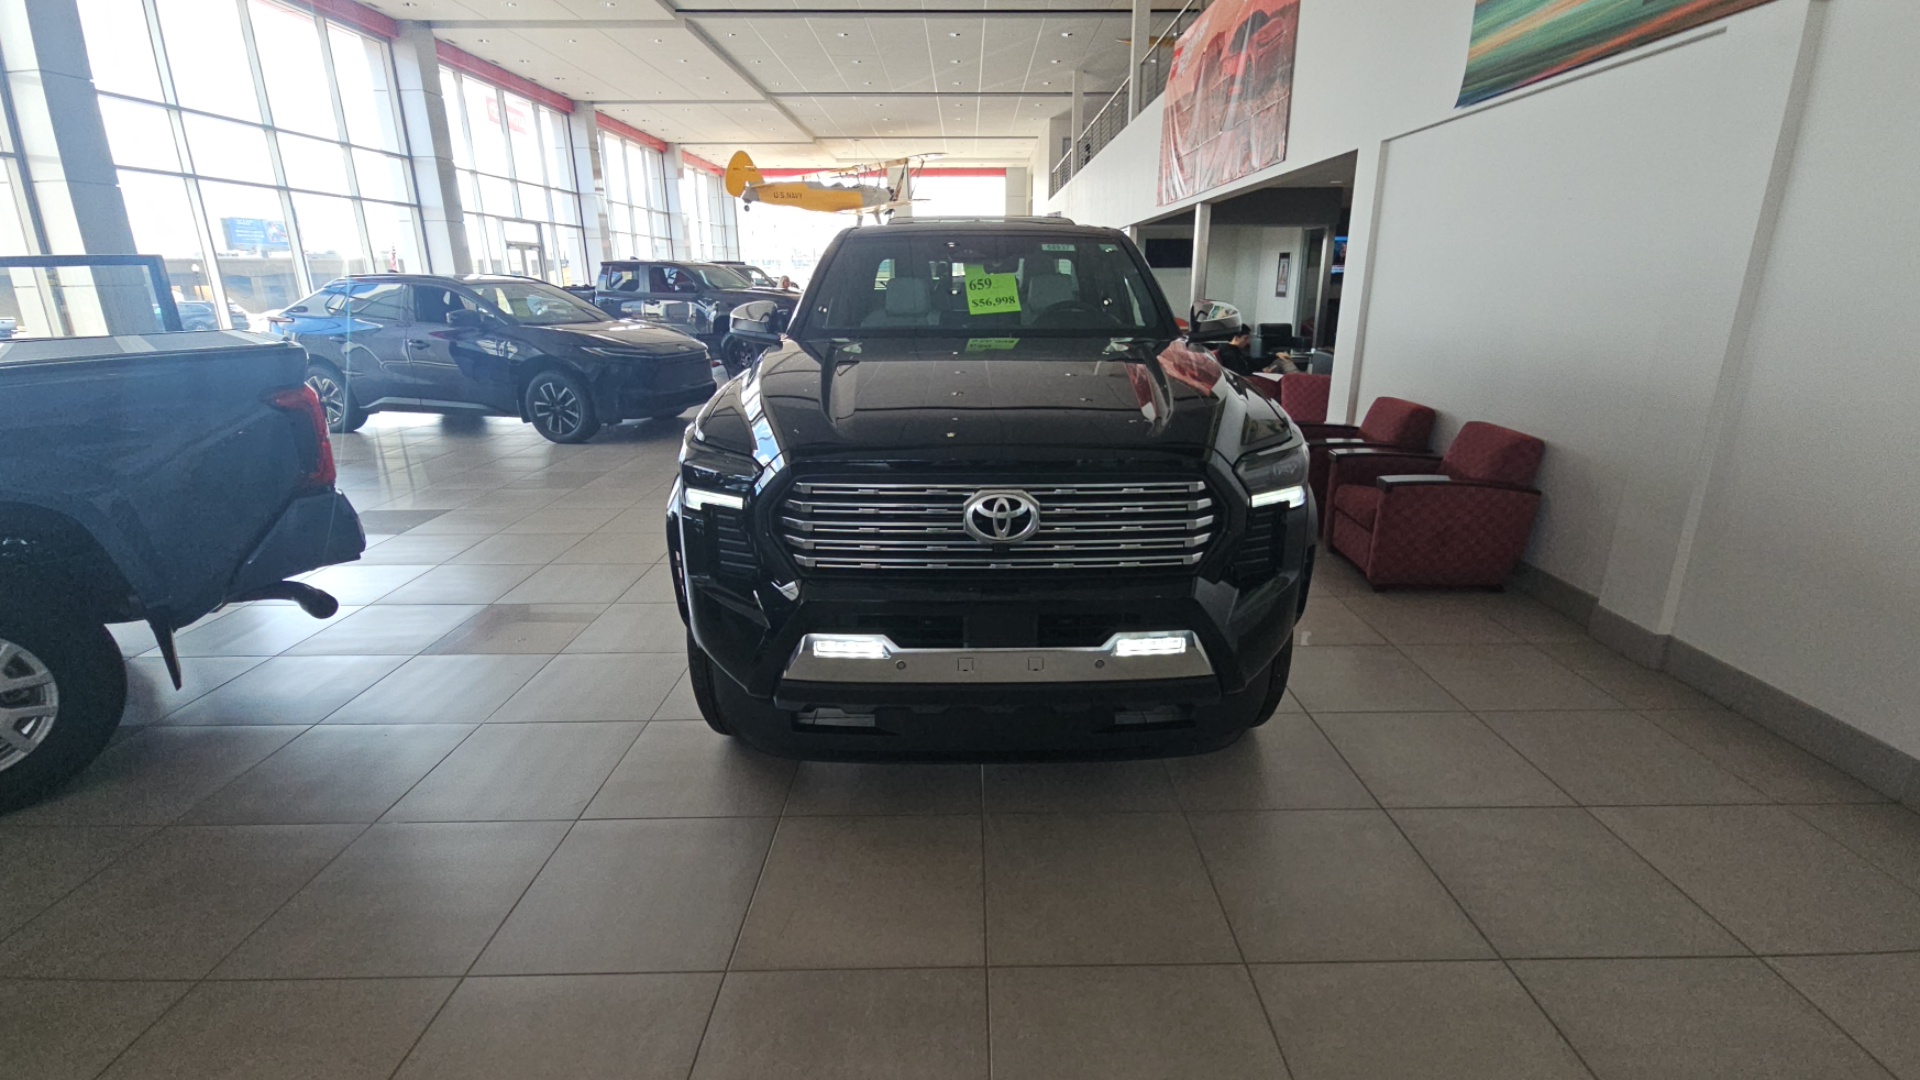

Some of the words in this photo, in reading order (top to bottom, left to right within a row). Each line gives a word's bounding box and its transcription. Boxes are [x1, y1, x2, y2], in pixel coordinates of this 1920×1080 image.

[786, 191, 803, 199] NAVY
[969, 278, 992, 290] 659
[971, 296, 1016, 307] $56,998
